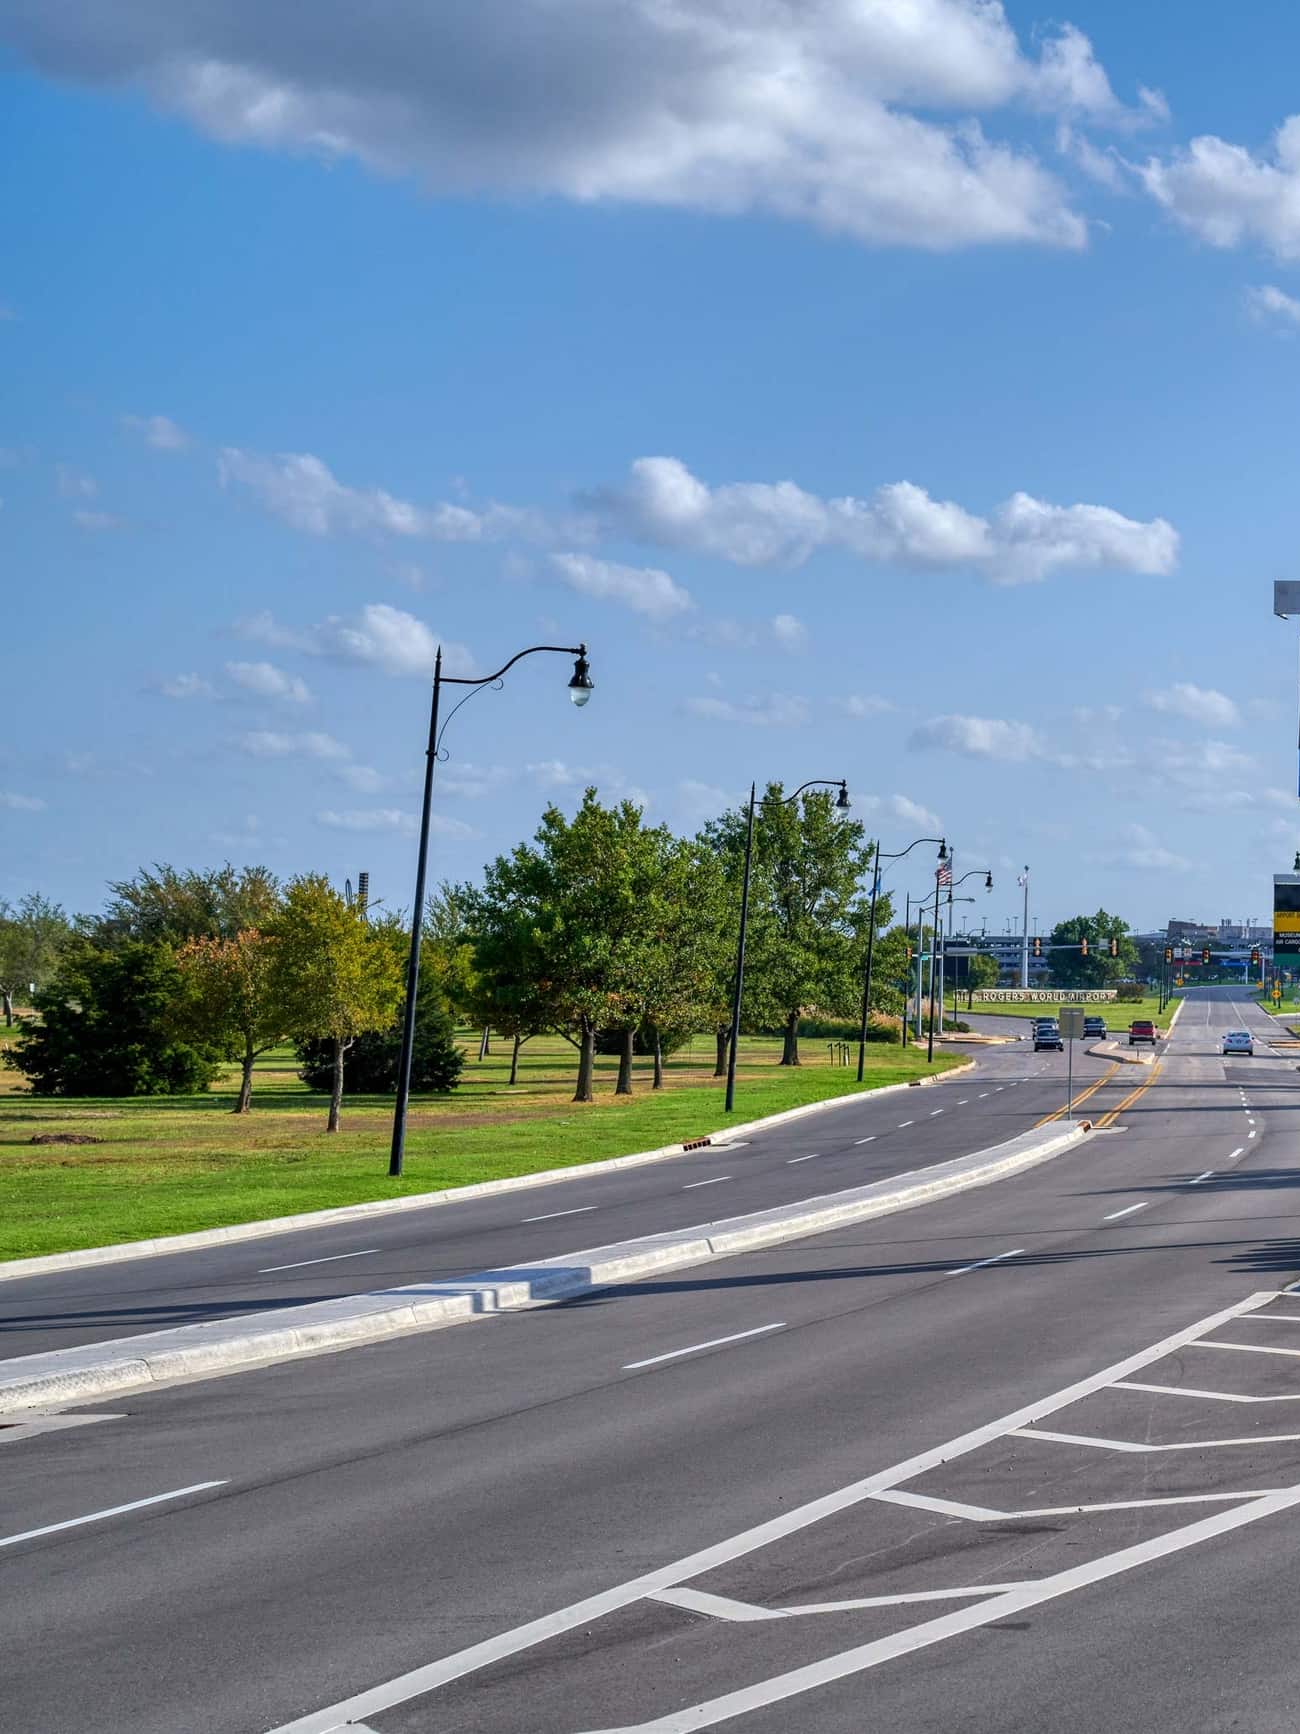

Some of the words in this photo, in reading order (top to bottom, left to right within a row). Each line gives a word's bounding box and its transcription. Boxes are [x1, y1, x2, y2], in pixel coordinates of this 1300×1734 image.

[983, 991, 1025, 1001] ROGERS
[1030, 991, 1066, 1001] WORLD
[1067, 991, 1114, 1001] AIRPORT
